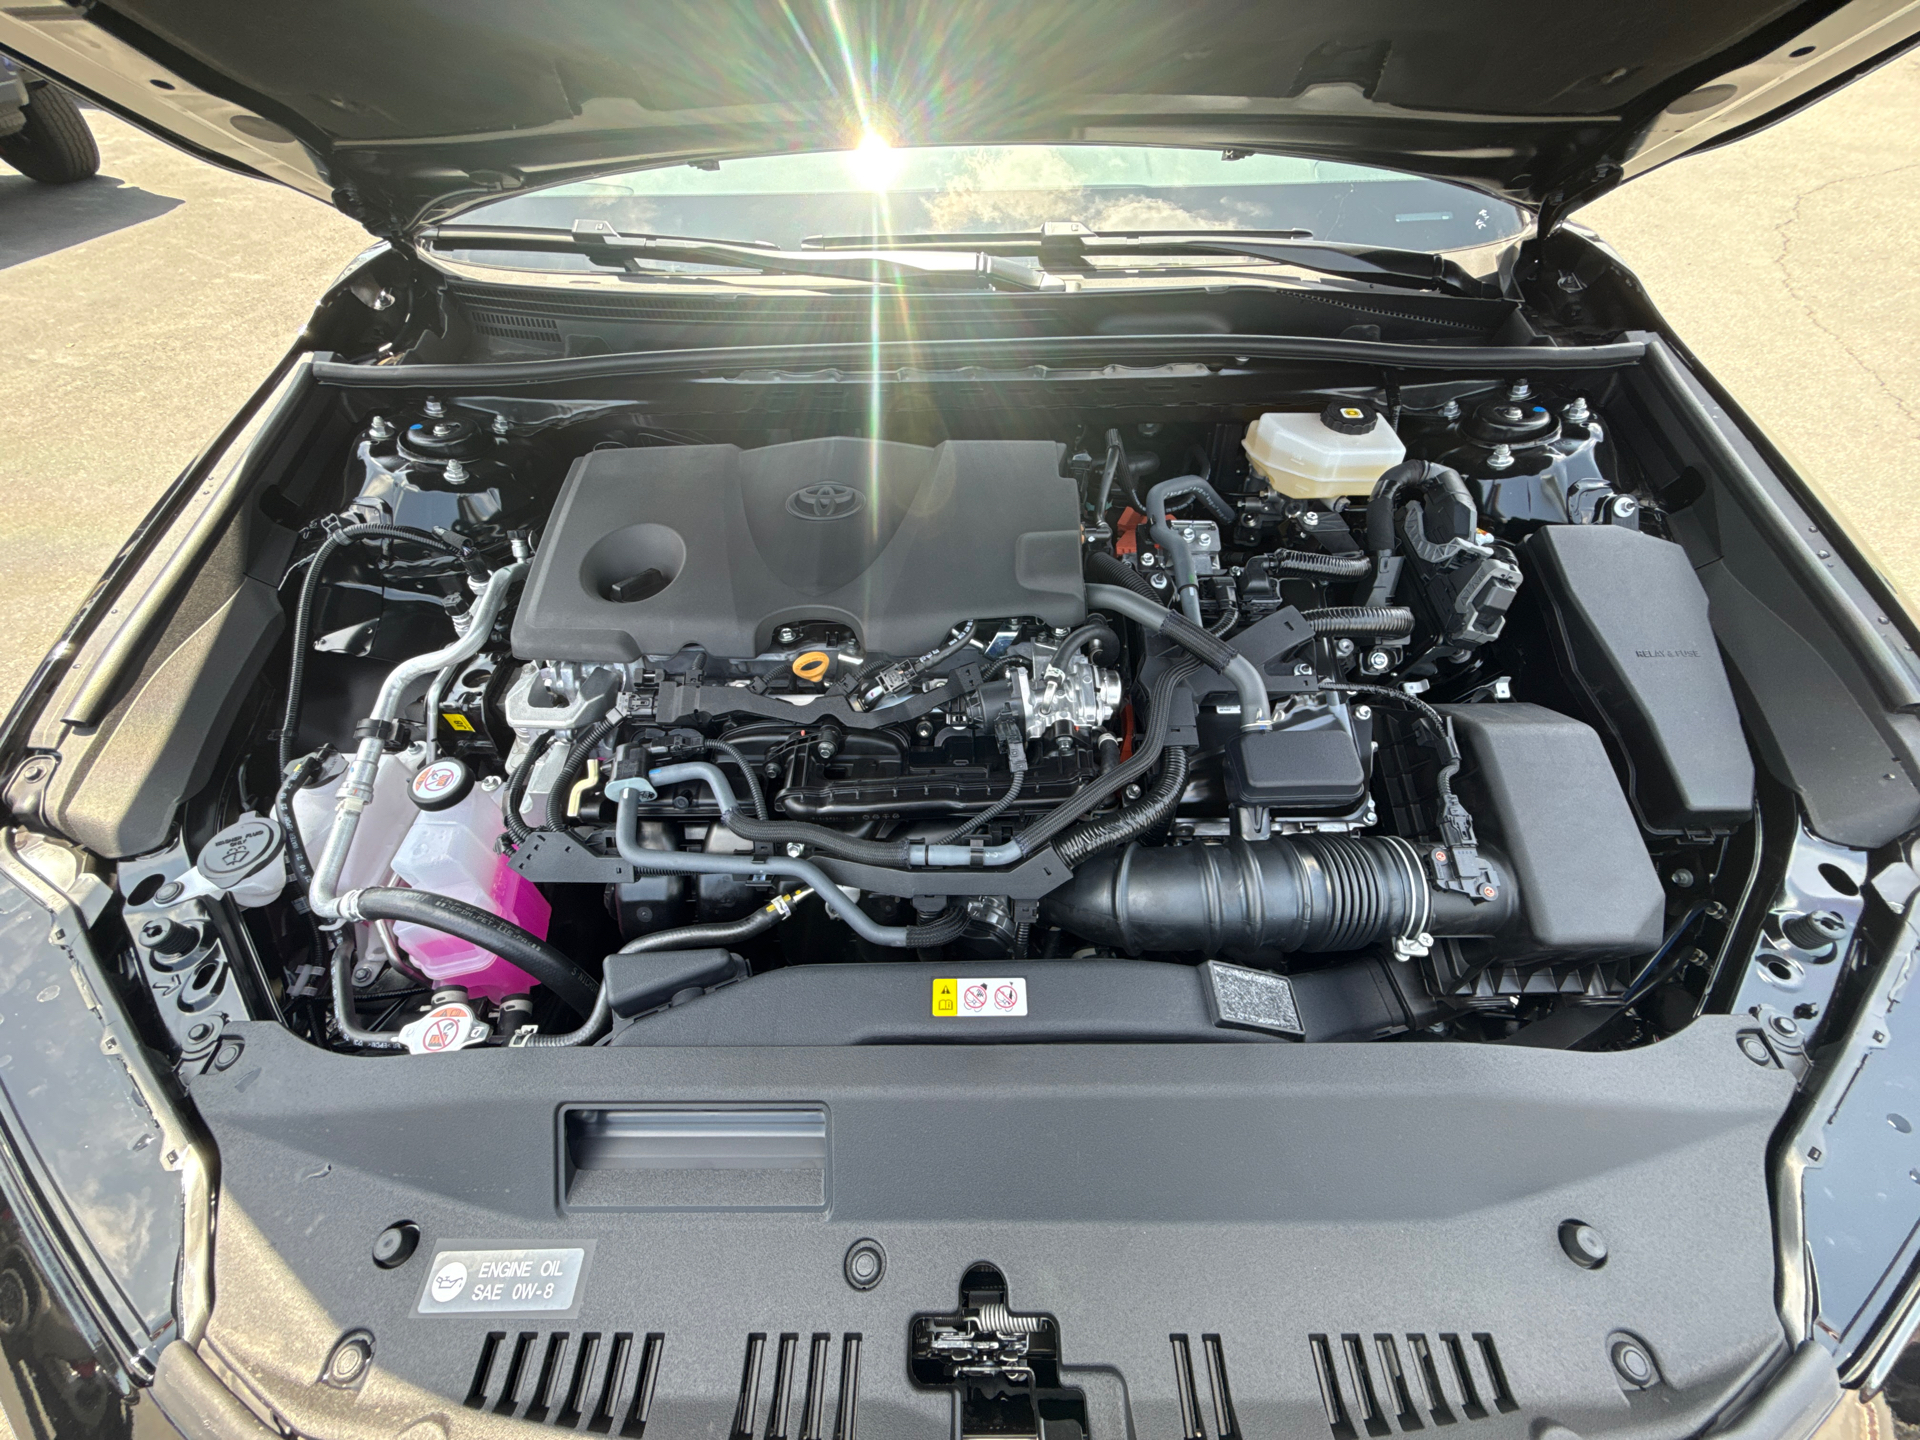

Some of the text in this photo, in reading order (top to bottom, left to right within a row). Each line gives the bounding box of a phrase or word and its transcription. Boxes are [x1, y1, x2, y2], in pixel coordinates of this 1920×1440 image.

[1636, 650, 1701, 658] RELAY & FUSE
[215, 836, 242, 847] WASHER
[478, 1260, 563, 1278] ENGINE OIL
[471, 1282, 554, 1301] SAE 0W-8
